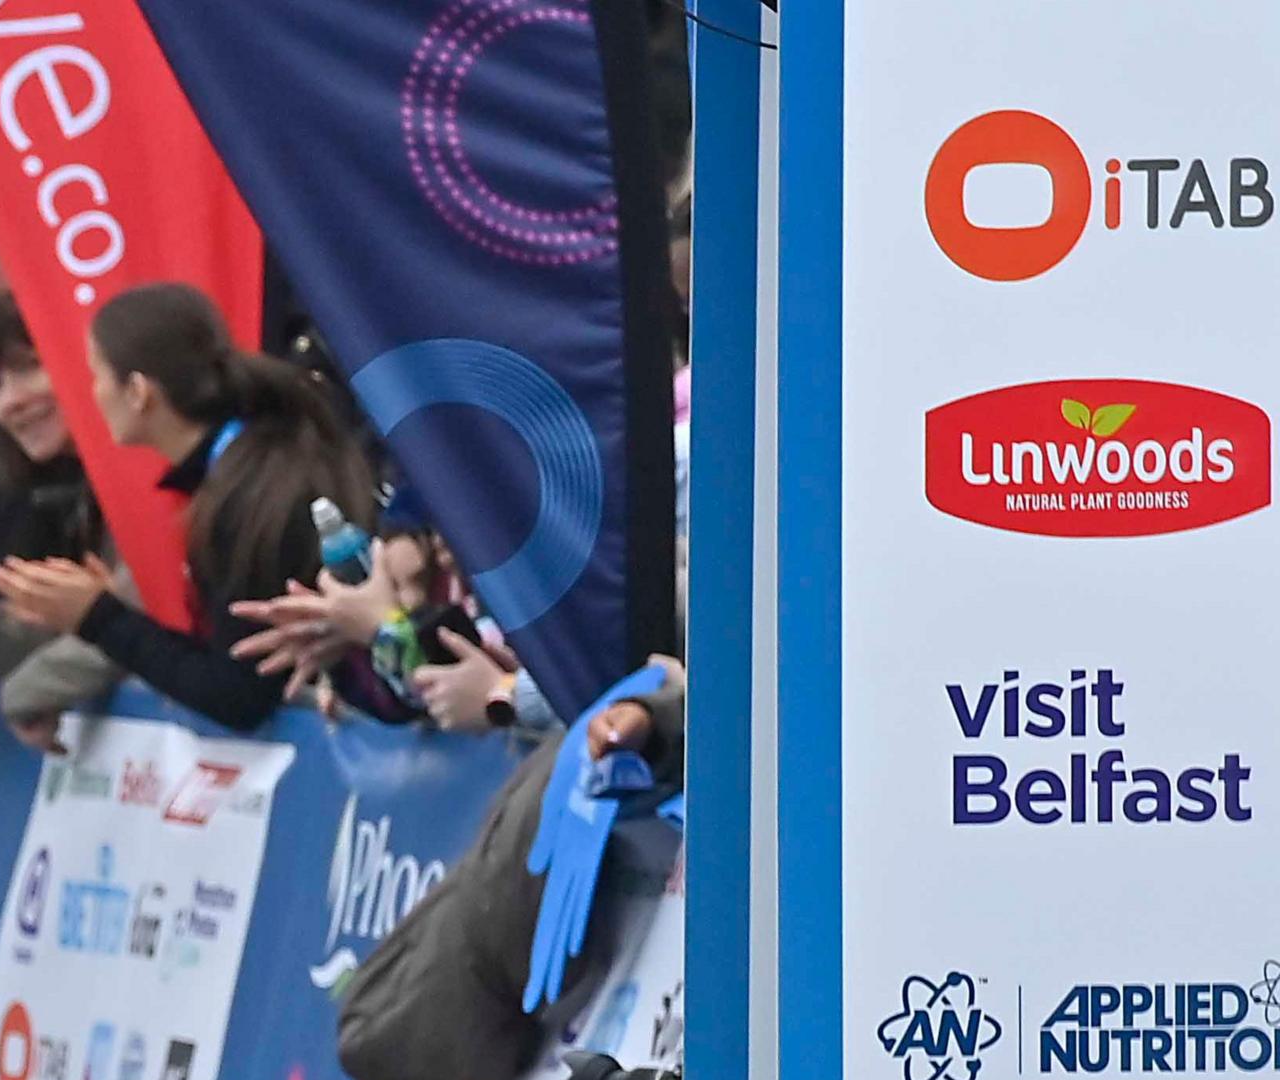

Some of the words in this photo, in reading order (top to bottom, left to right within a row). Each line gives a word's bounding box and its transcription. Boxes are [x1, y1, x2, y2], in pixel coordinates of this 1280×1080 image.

[1104, 157, 1274, 230] iTAB
[1006, 493, 1066, 511] NATURAL
[1070, 492, 1113, 510] PLANT
[1117, 491, 1189, 509] GOODNESS
[945, 669, 1125, 738] visit
[953, 750, 1252, 825] Belfast
[1041, 984, 1249, 1028] APPLIED
[893, 1009, 982, 1057] AN
[1040, 1028, 1280, 1073] NUTRITIO
